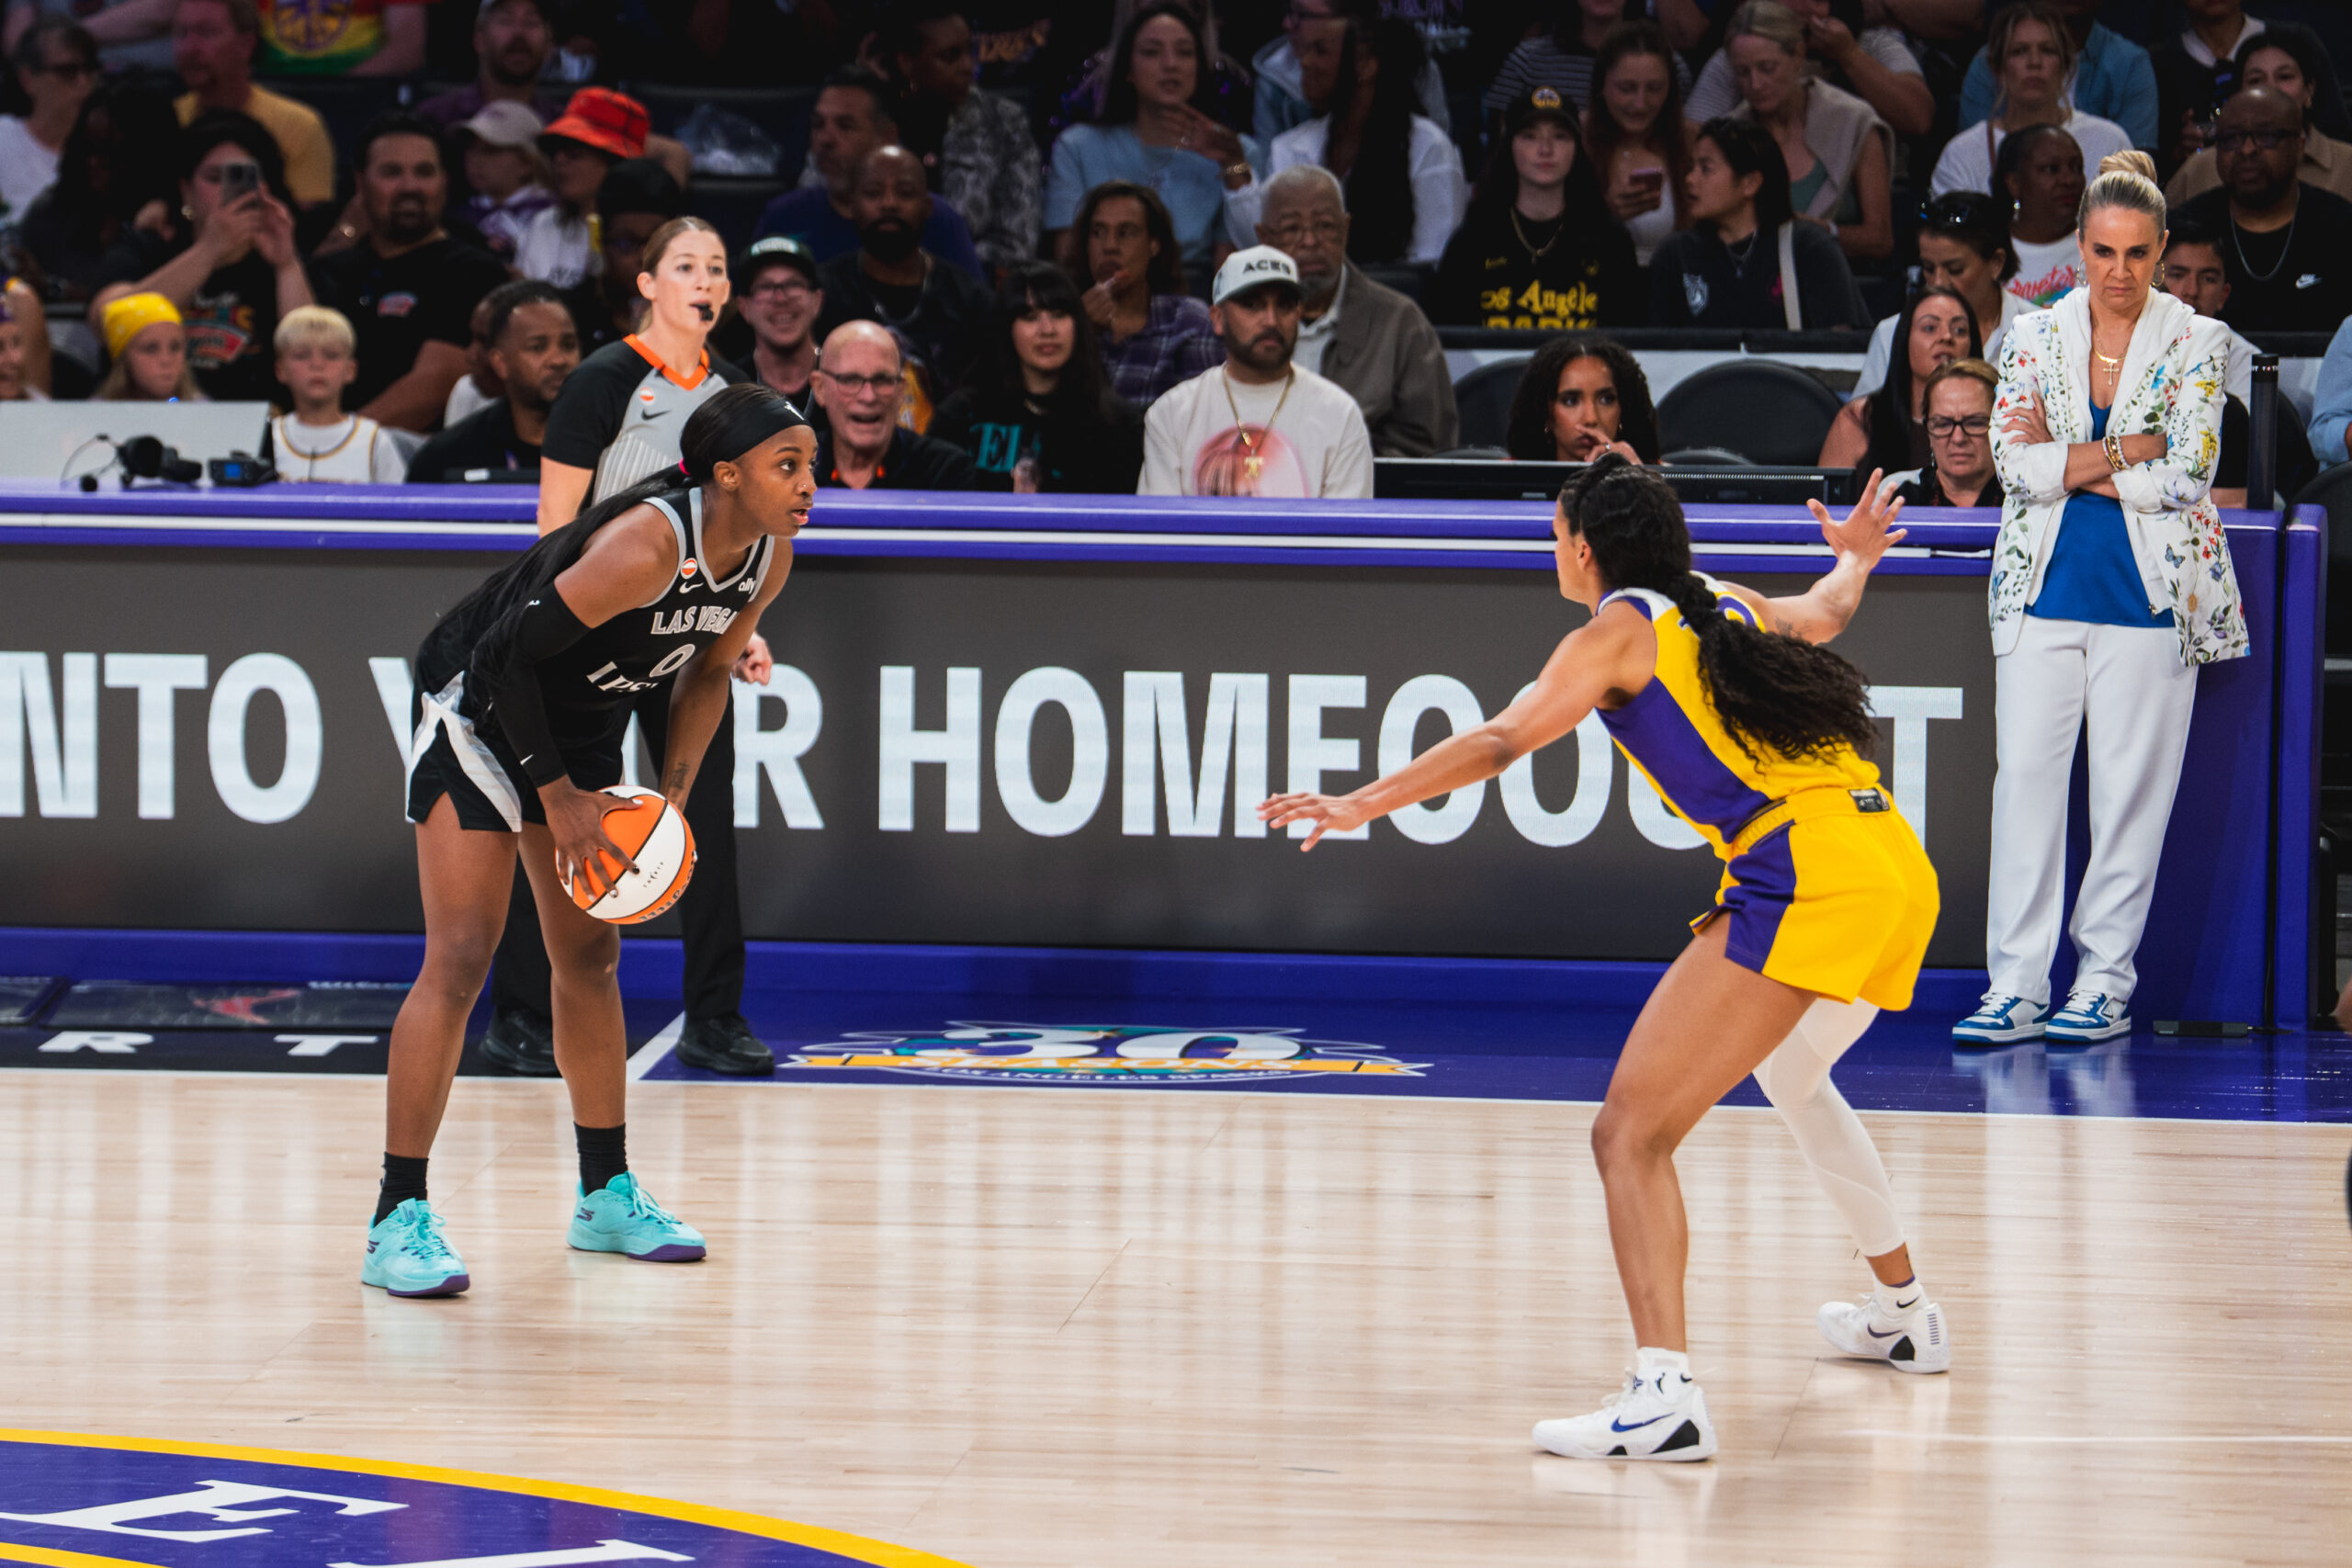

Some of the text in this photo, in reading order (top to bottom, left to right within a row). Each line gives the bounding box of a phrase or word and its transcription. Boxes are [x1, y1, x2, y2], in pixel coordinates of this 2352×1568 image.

[1479, 279, 1600, 318] os Angele
[739, 578, 756, 594] ally
[650, 606, 739, 635] LAS VEGA
[649, 644, 695, 678] 0
[877, 666, 1963, 851] HOMECOT
[916, 1028, 1303, 1059] 30
[898, 1057, 1302, 1071] SEASONS
